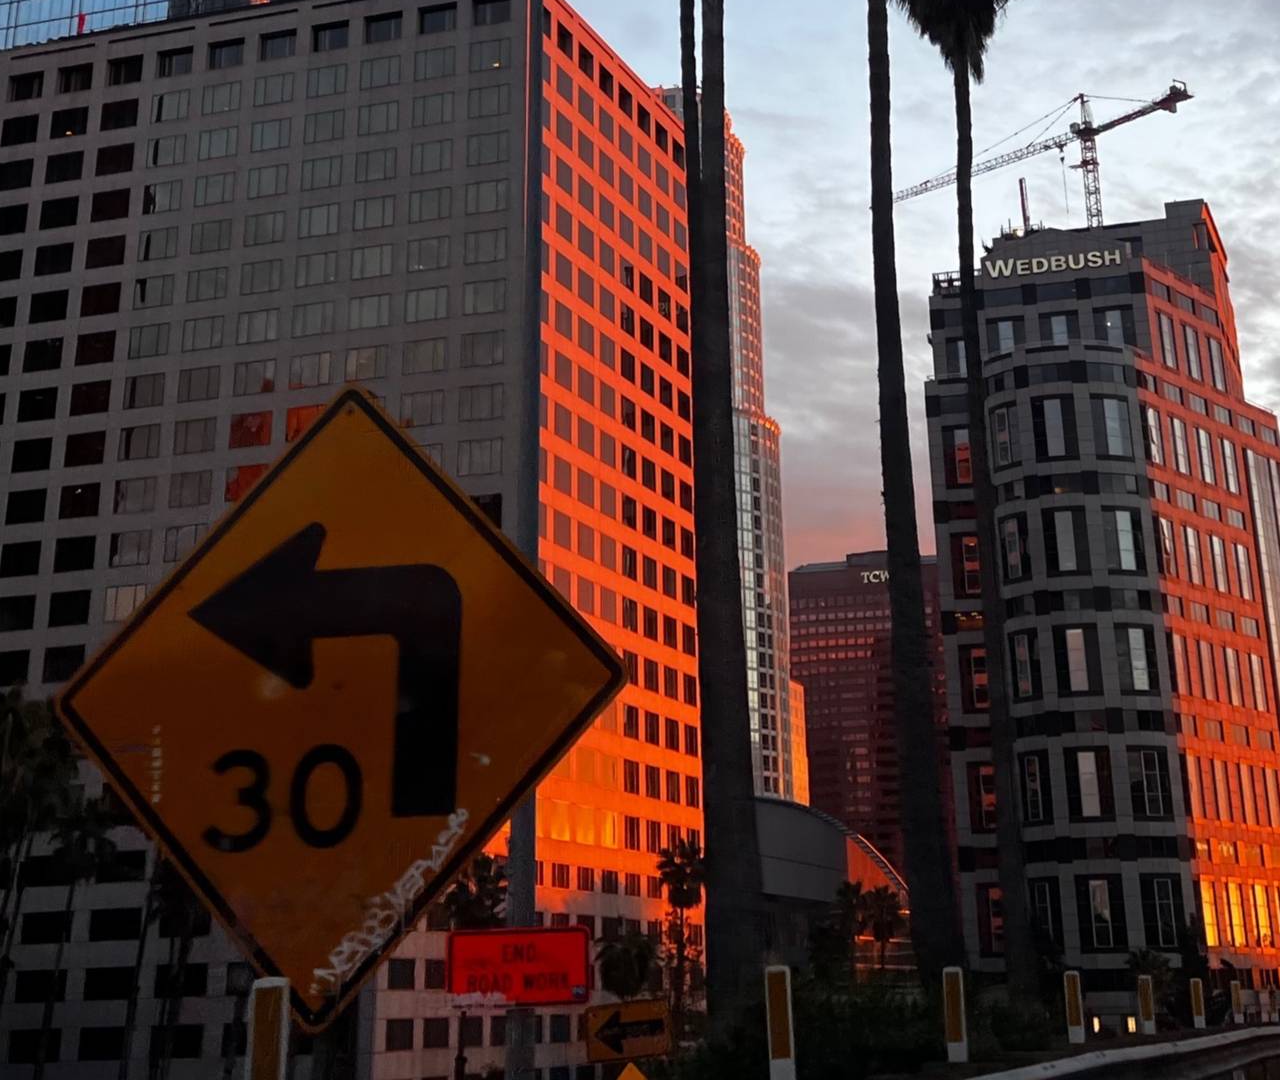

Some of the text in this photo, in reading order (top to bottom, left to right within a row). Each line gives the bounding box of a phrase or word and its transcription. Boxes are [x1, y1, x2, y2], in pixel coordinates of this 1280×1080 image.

[985, 249, 1122, 279] WEDBUSH
[860, 570, 890, 584] TCW
[203, 744, 364, 852] 30
[501, 944, 537, 965] END
[467, 971, 570, 994] ROAD WORK
